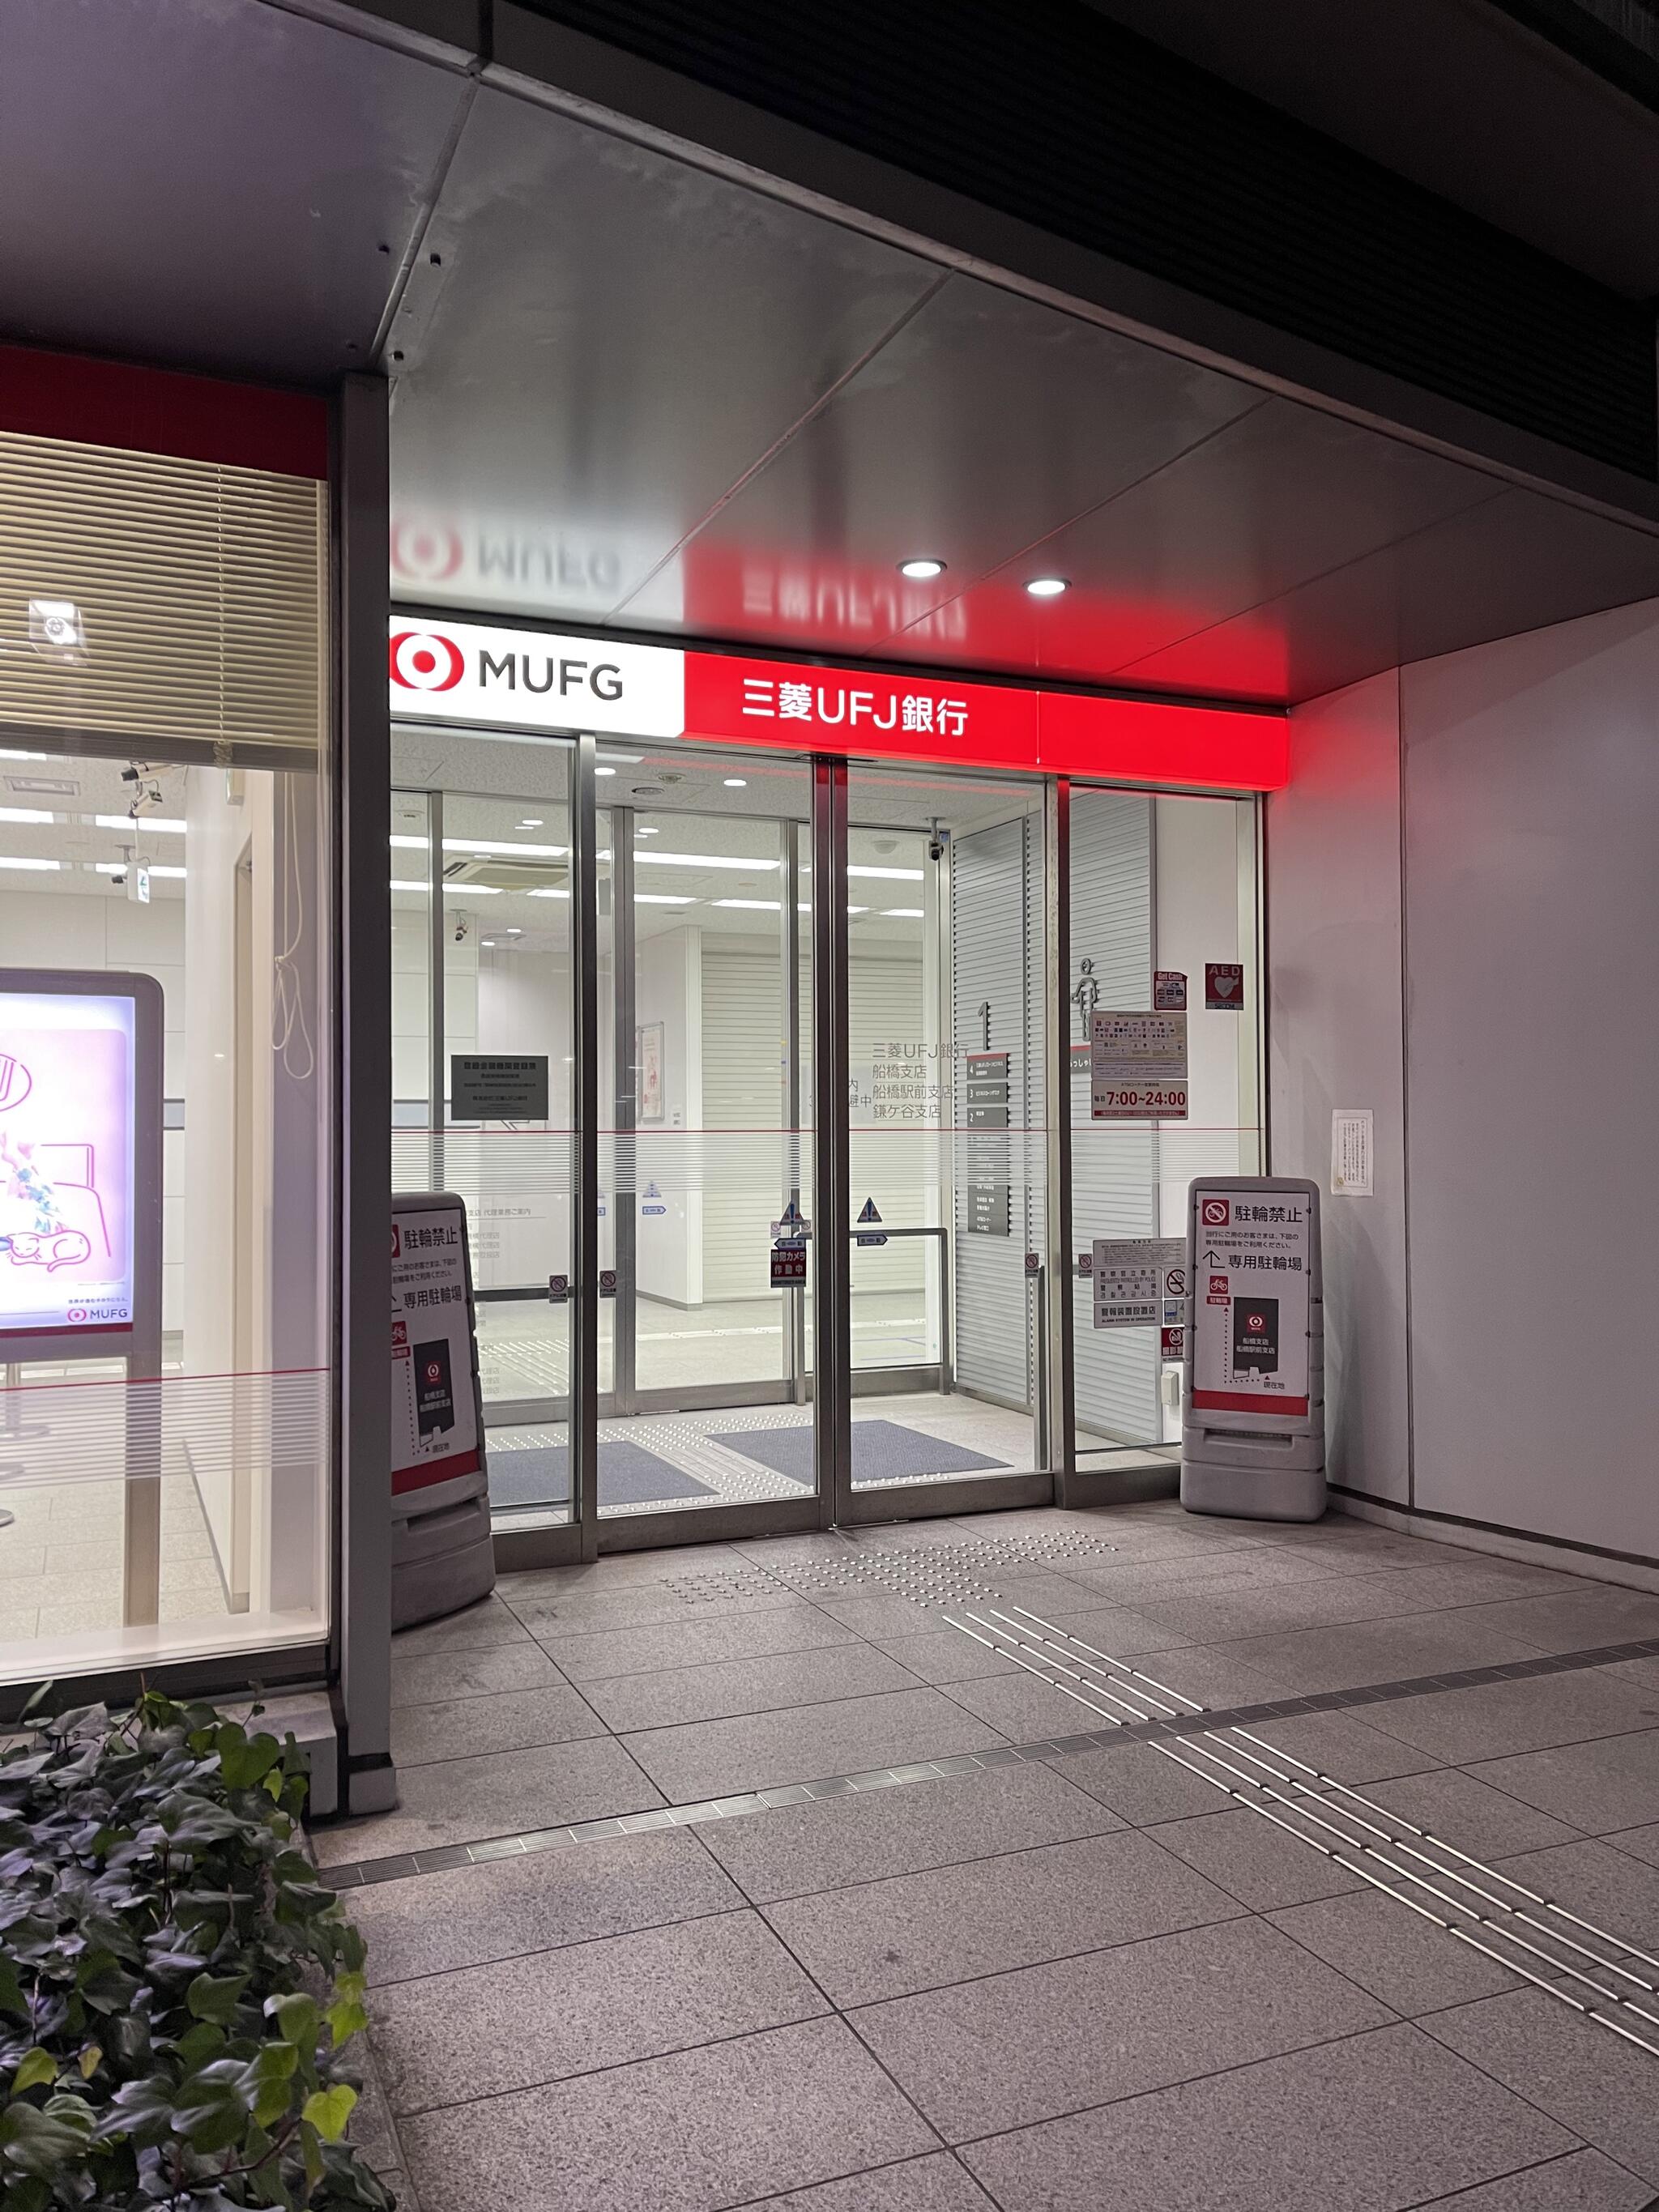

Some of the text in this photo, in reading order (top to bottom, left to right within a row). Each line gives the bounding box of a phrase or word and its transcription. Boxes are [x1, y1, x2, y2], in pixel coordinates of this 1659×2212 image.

[479, 650, 623, 701] MUFG
[743, 679, 968, 735] 三菱UFJ銀行
[1209, 965, 1240, 976] AED
[872, 1042, 969, 1059] 三菱UFJ銀行
[872, 1064, 927, 1080] 船橋支店
[872, 1085, 954, 1100] 船橋駅前支店
[1235, 1205, 1303, 1223] 駐輪禁止
[404, 1226, 458, 1249] 駐輪禁止
[772, 1251, 806, 1261] 防犯カメラ
[1228, 1255, 1303, 1272] 専用駐輪場
[774, 1264, 803, 1275] 作動中
[403, 1285, 462, 1309] 専用駐輪場
[90, 1308, 128, 1319] MUFG
[1263, 1381, 1285, 1390] 現在地
